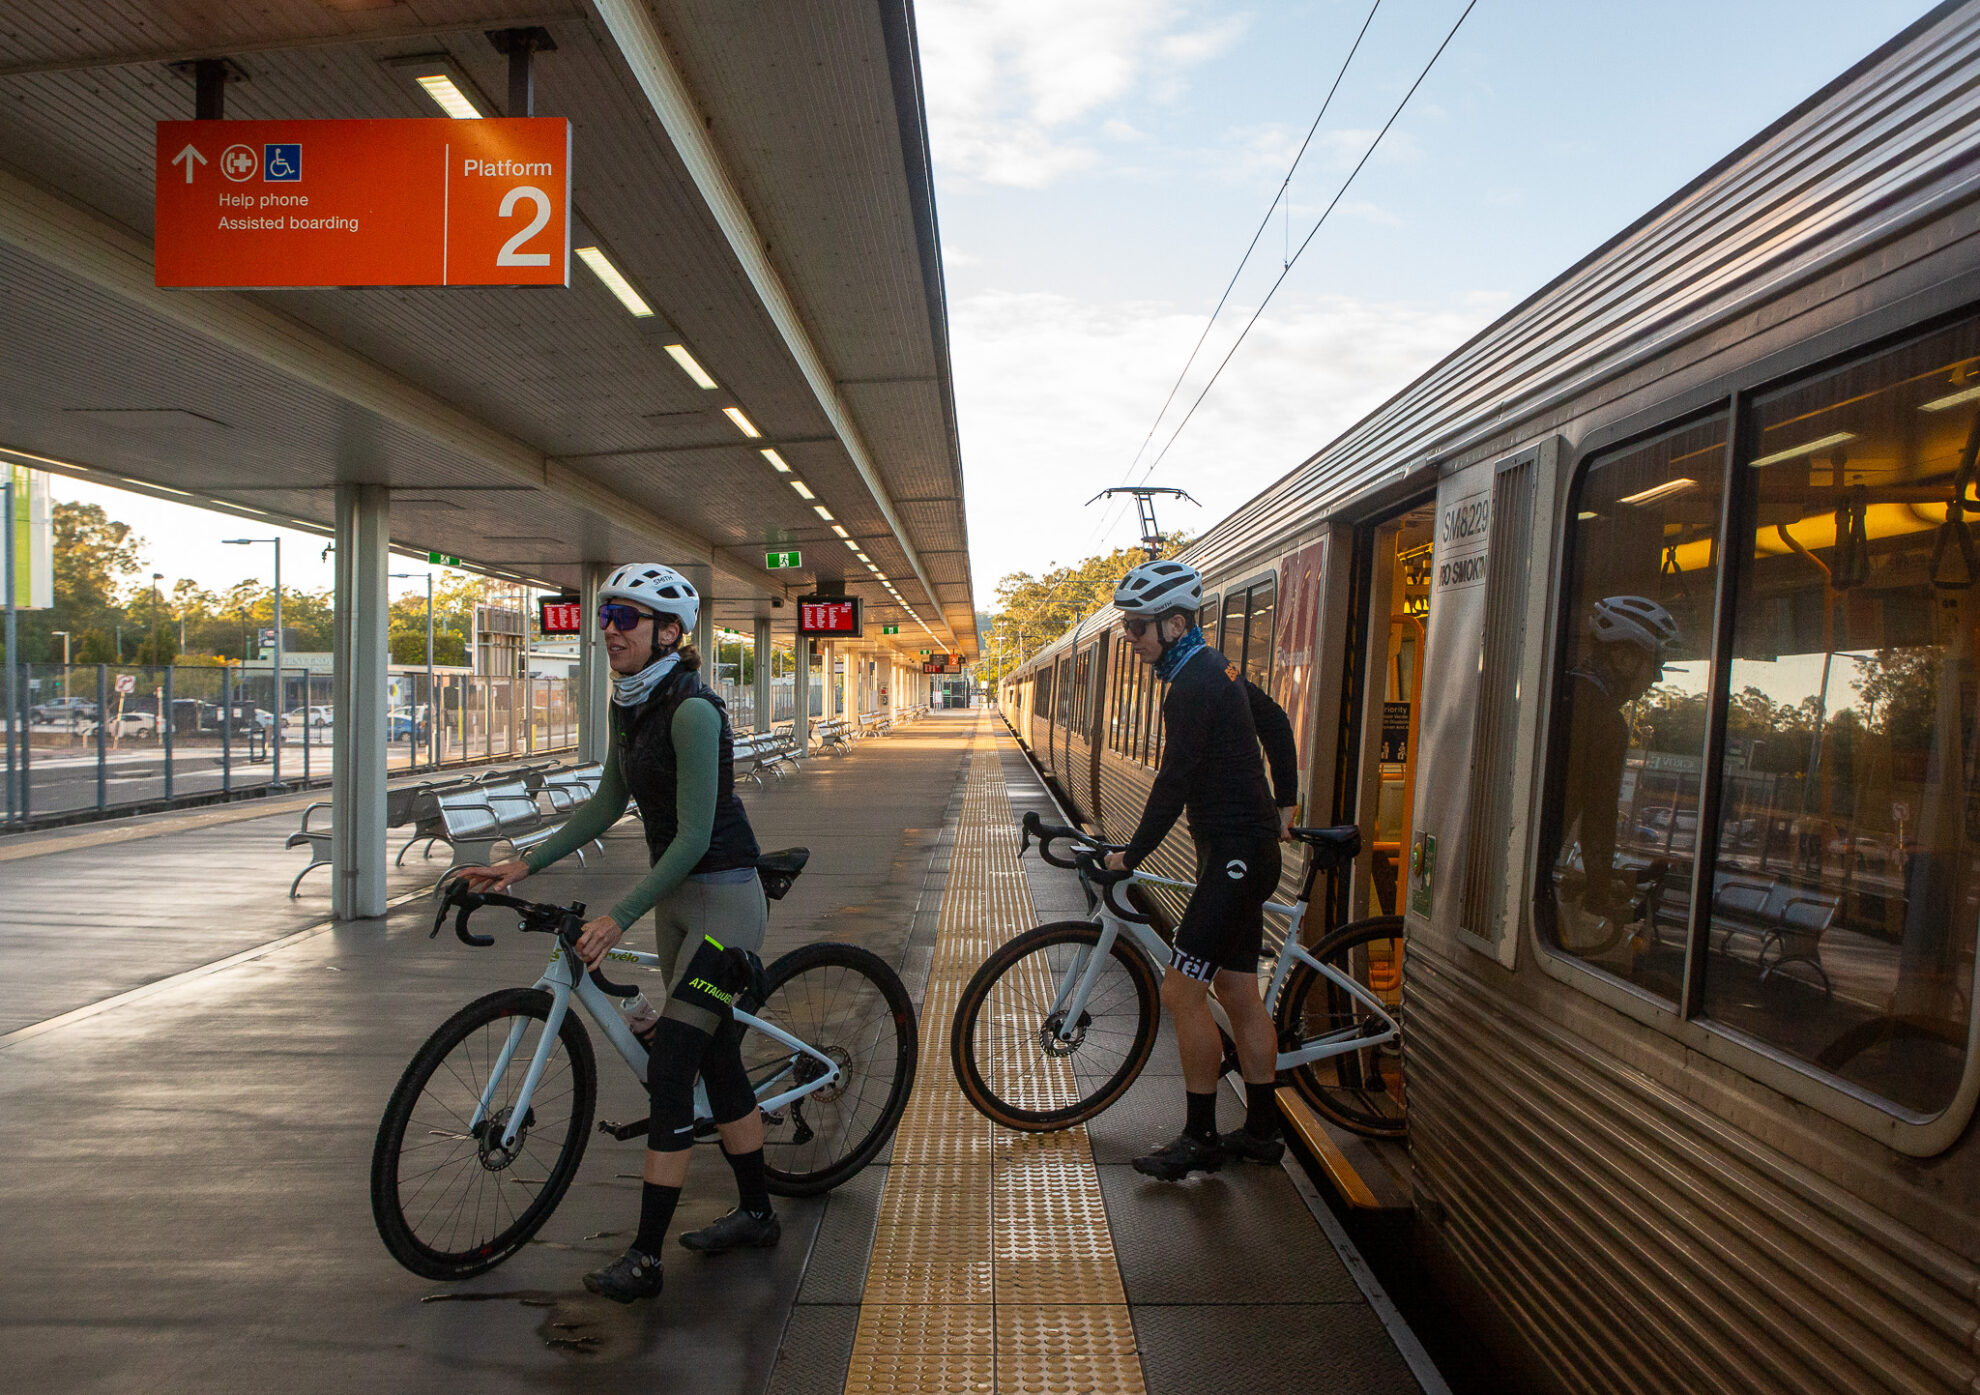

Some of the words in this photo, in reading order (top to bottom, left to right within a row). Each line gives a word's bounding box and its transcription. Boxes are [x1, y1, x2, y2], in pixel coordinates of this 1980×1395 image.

[464, 158, 553, 177] Platform
[218, 192, 255, 209] Help
[259, 193, 309, 208] phone
[218, 215, 285, 230] Assisted
[290, 215, 360, 233] boarding
[496, 185, 552, 267] 2
[1443, 499, 1489, 543] SM8229
[606, 952, 640, 963] rvélo
